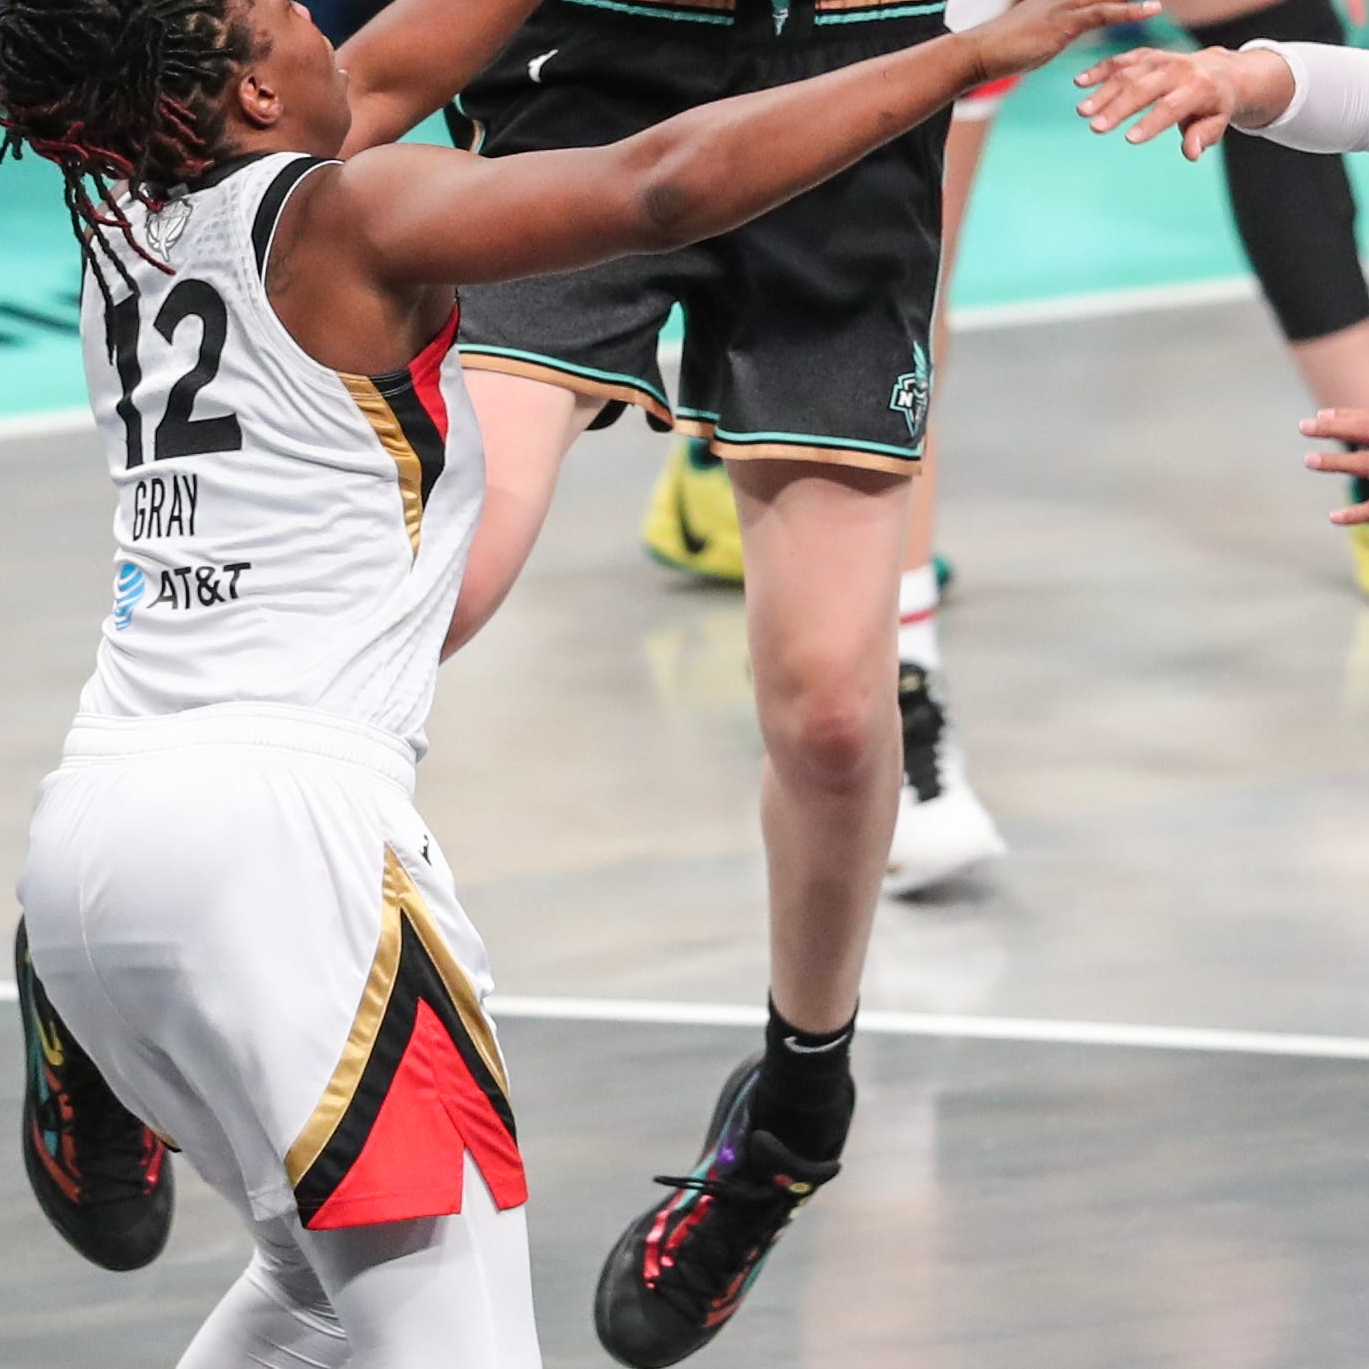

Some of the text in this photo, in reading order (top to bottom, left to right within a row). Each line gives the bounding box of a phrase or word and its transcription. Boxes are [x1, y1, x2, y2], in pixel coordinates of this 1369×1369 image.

[114, 278, 243, 471] 12
[133, 473, 198, 542] GRAY
[146, 561, 252, 610] AT&T
